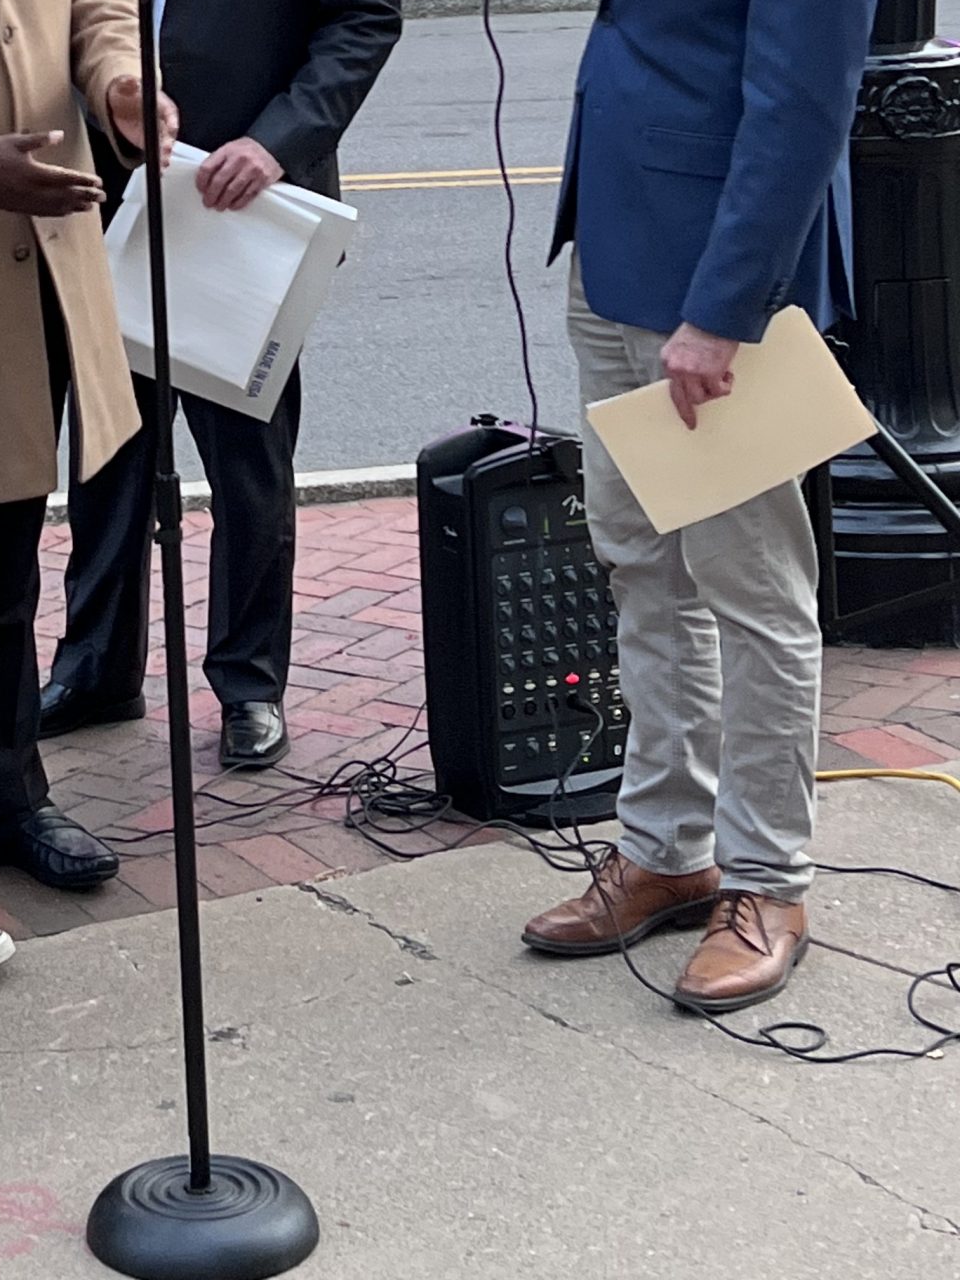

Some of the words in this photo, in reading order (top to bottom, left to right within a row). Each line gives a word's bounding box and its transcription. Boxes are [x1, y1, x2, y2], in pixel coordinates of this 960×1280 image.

[259, 340, 281, 370] MADE
[254, 369, 269, 381] IN
[246, 380, 263, 398] USA
